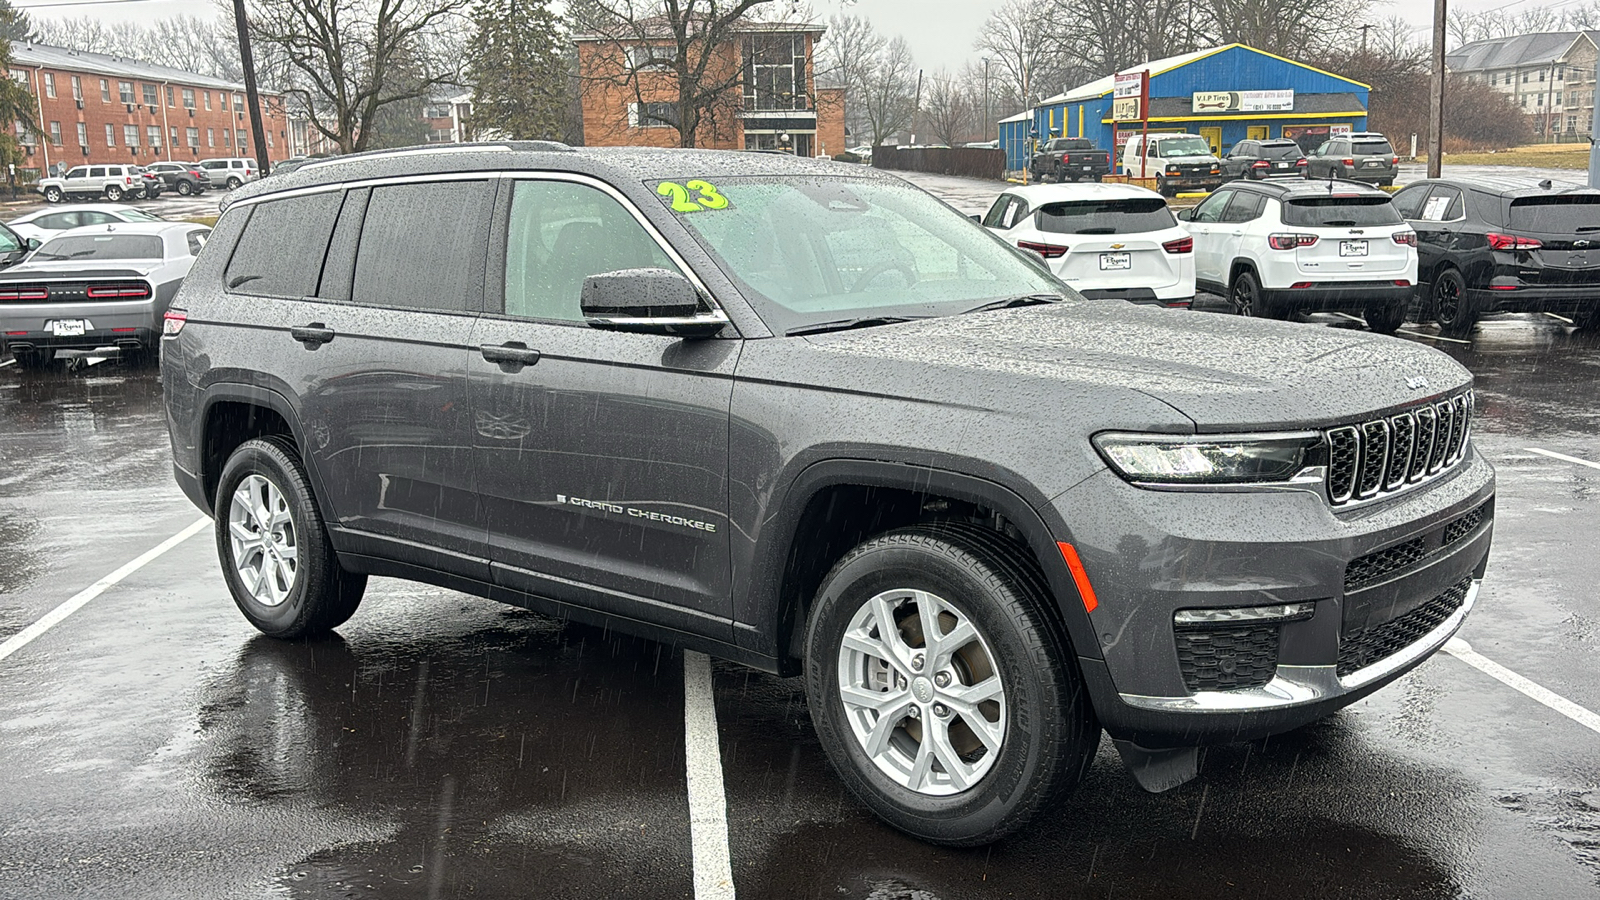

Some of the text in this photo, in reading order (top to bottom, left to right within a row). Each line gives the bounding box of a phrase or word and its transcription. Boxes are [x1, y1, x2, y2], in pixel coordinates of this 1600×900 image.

[657, 179, 729, 212] 23
[570, 496, 717, 534] GRAND CHEROKEE
